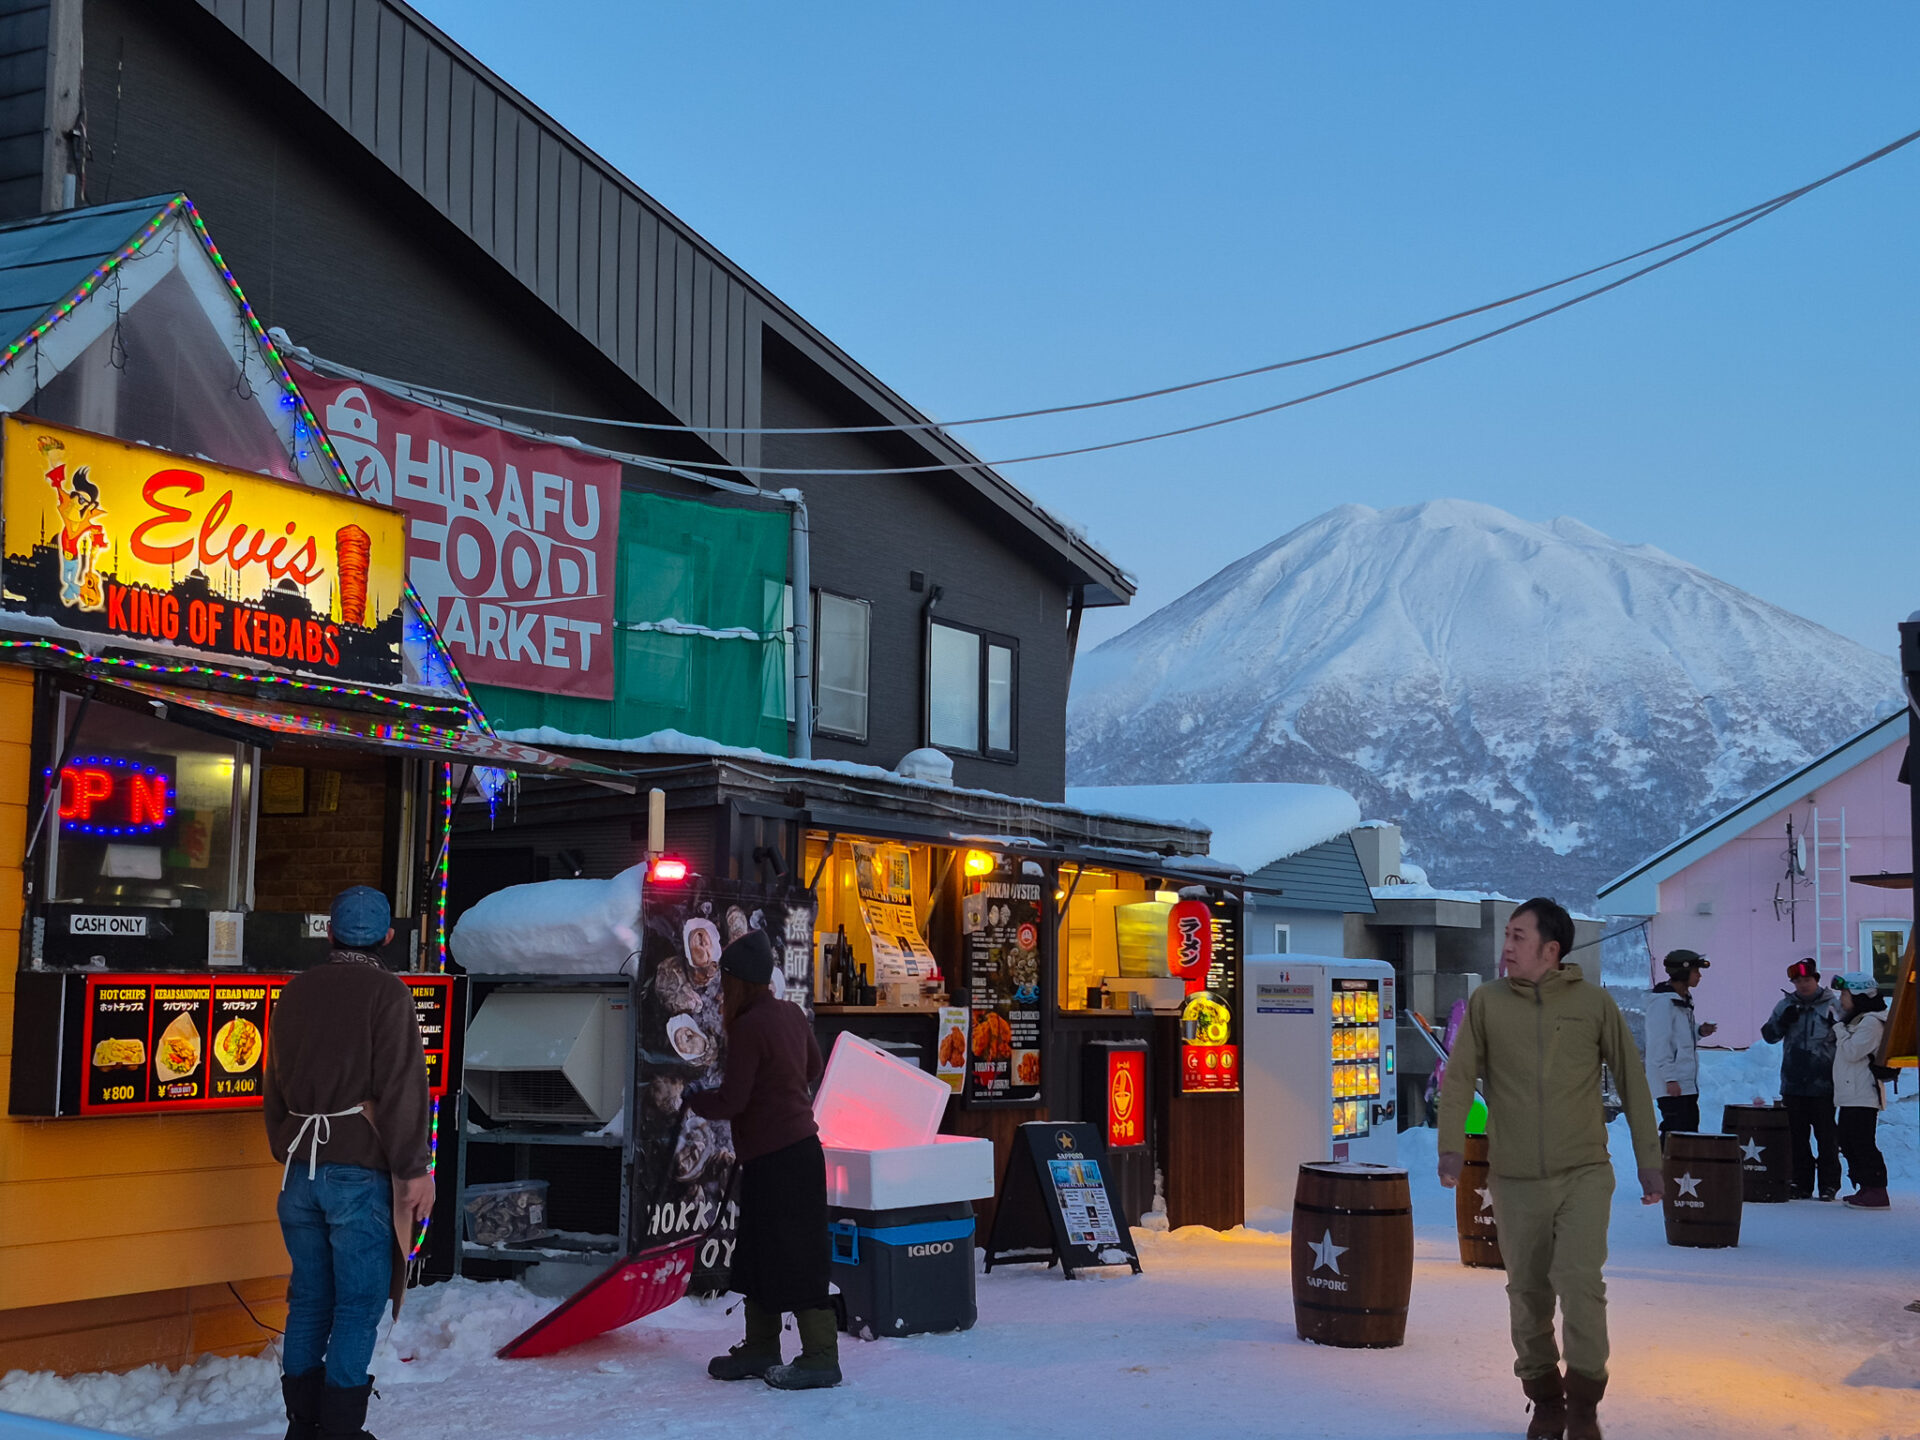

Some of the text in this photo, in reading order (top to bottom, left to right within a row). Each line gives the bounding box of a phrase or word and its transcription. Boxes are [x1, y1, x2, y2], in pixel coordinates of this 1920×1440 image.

[395, 433, 600, 541] HIRAFU
[130, 469, 324, 585] Elvis
[404, 498, 589, 598] FOOD
[108, 584, 340, 667] KING OF KEBABS
[430, 598, 602, 672] ARKET
[57, 767, 167, 824] OPN
[75, 917, 142, 933] CASH ONLY
[1178, 917, 1201, 967] ラーメン
[100, 989, 146, 1000] HOT CHIPS
[155, 989, 210, 1000] KEBAB SANDWICH
[215, 989, 242, 1000] KEBAB
[242, 989, 266, 1000] WRAP
[413, 988, 435, 997] MENU
[103, 1086, 135, 1100] ¥800
[217, 1079, 255, 1094] ¥1,400
[1056, 1152, 1084, 1160] SAPPORO
[908, 1242, 954, 1258] IGLOO
[1306, 1276, 1349, 1291] SAPPORO
